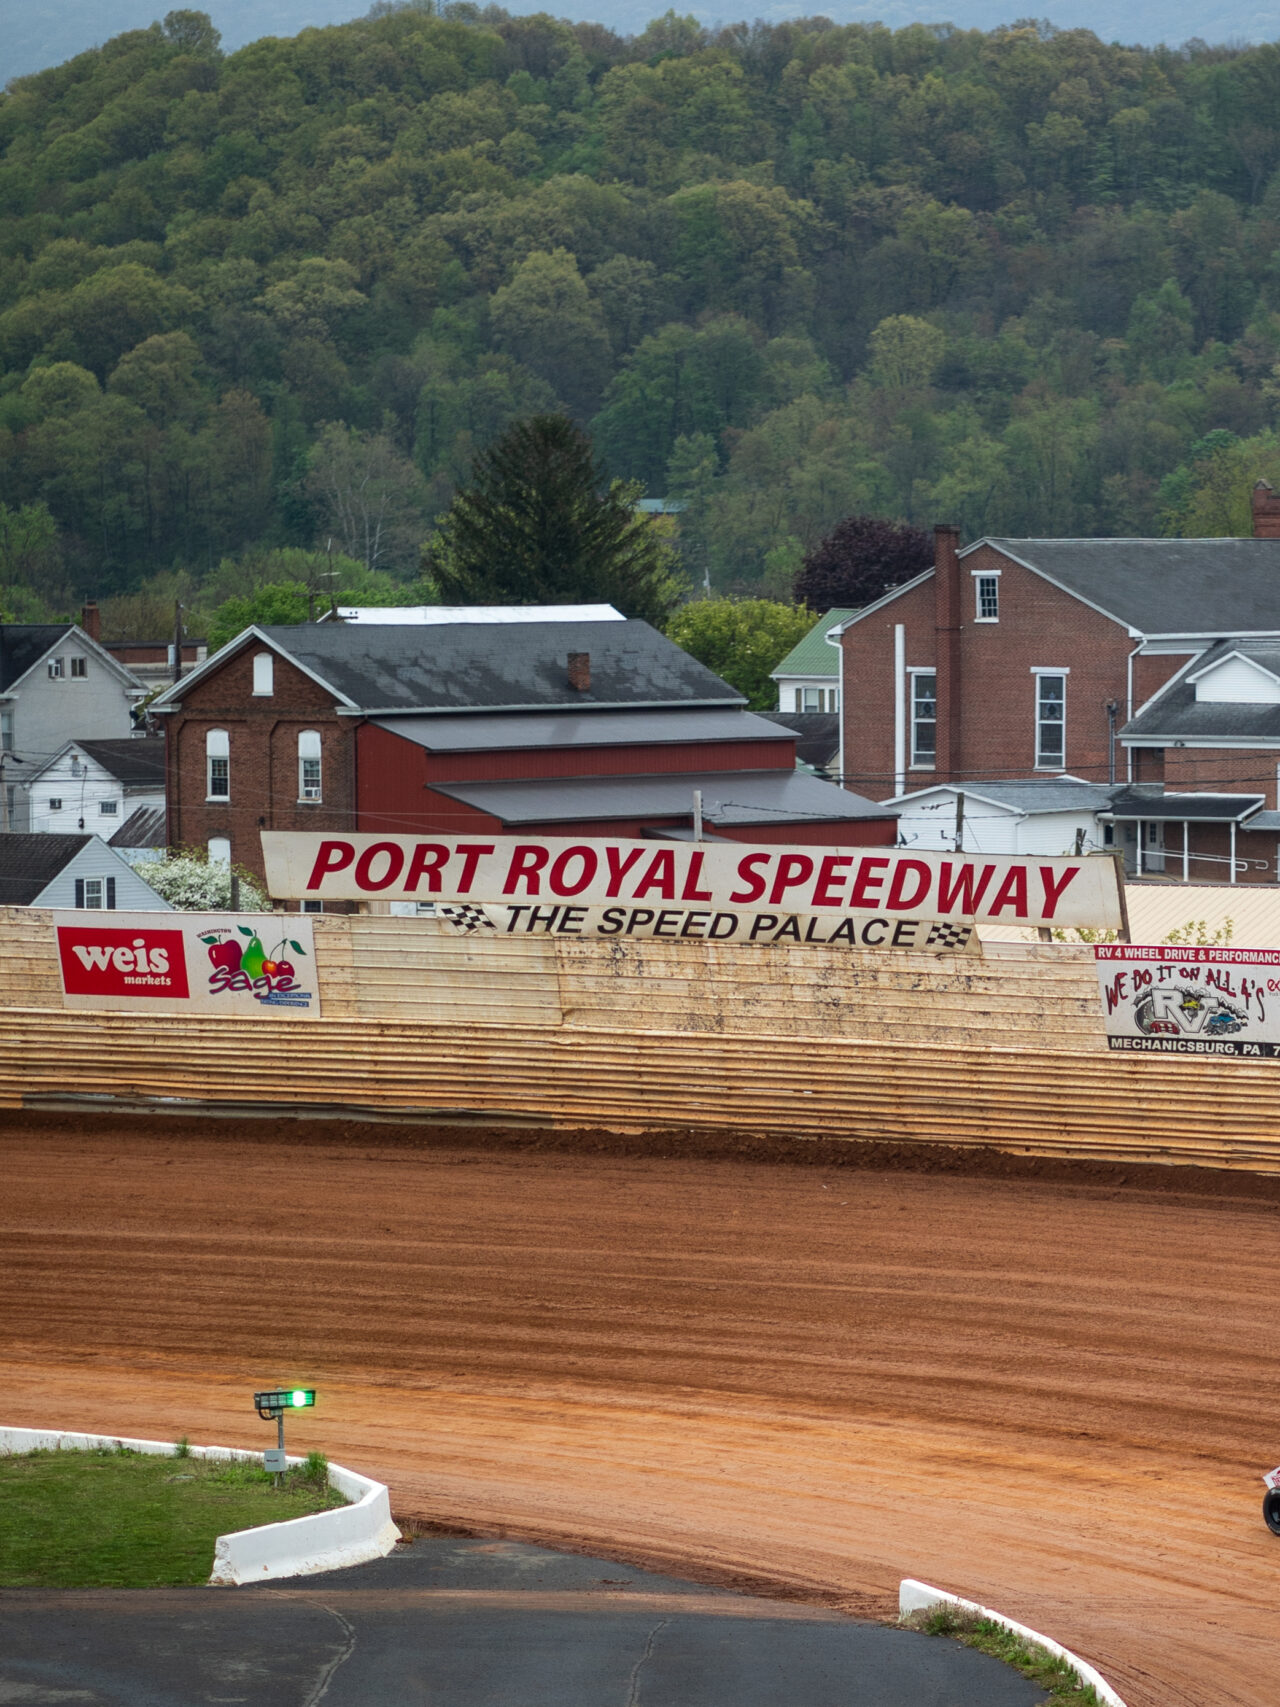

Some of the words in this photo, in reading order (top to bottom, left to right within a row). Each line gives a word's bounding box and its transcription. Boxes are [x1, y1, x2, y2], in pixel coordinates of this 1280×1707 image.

[306, 841, 495, 893] PORT
[502, 845, 713, 901] ROYAL
[729, 852, 1081, 918] SPEEDWAY
[506, 905, 589, 933] THE
[597, 908, 738, 940] SPEED
[749, 914, 920, 947] PALACE
[72, 938, 169, 974] weis
[1098, 947, 1112, 958] RV
[1115, 948, 1121, 958] 4
[1124, 948, 1161, 959] WHEEL
[1164, 949, 1195, 960] DRIVE
[1198, 949, 1206, 960] &
[124, 975, 171, 986] markets
[1105, 972, 1128, 1015] WE
[1131, 968, 1152, 992] DO
[1156, 965, 1176, 982] IT
[1178, 967, 1200, 981] ON
[1205, 968, 1236, 998] ALL
[1151, 988, 1220, 1033] RV
[1111, 1038, 1239, 1056] MECHANICSBURG,
[1243, 1044, 1260, 1055] PA
